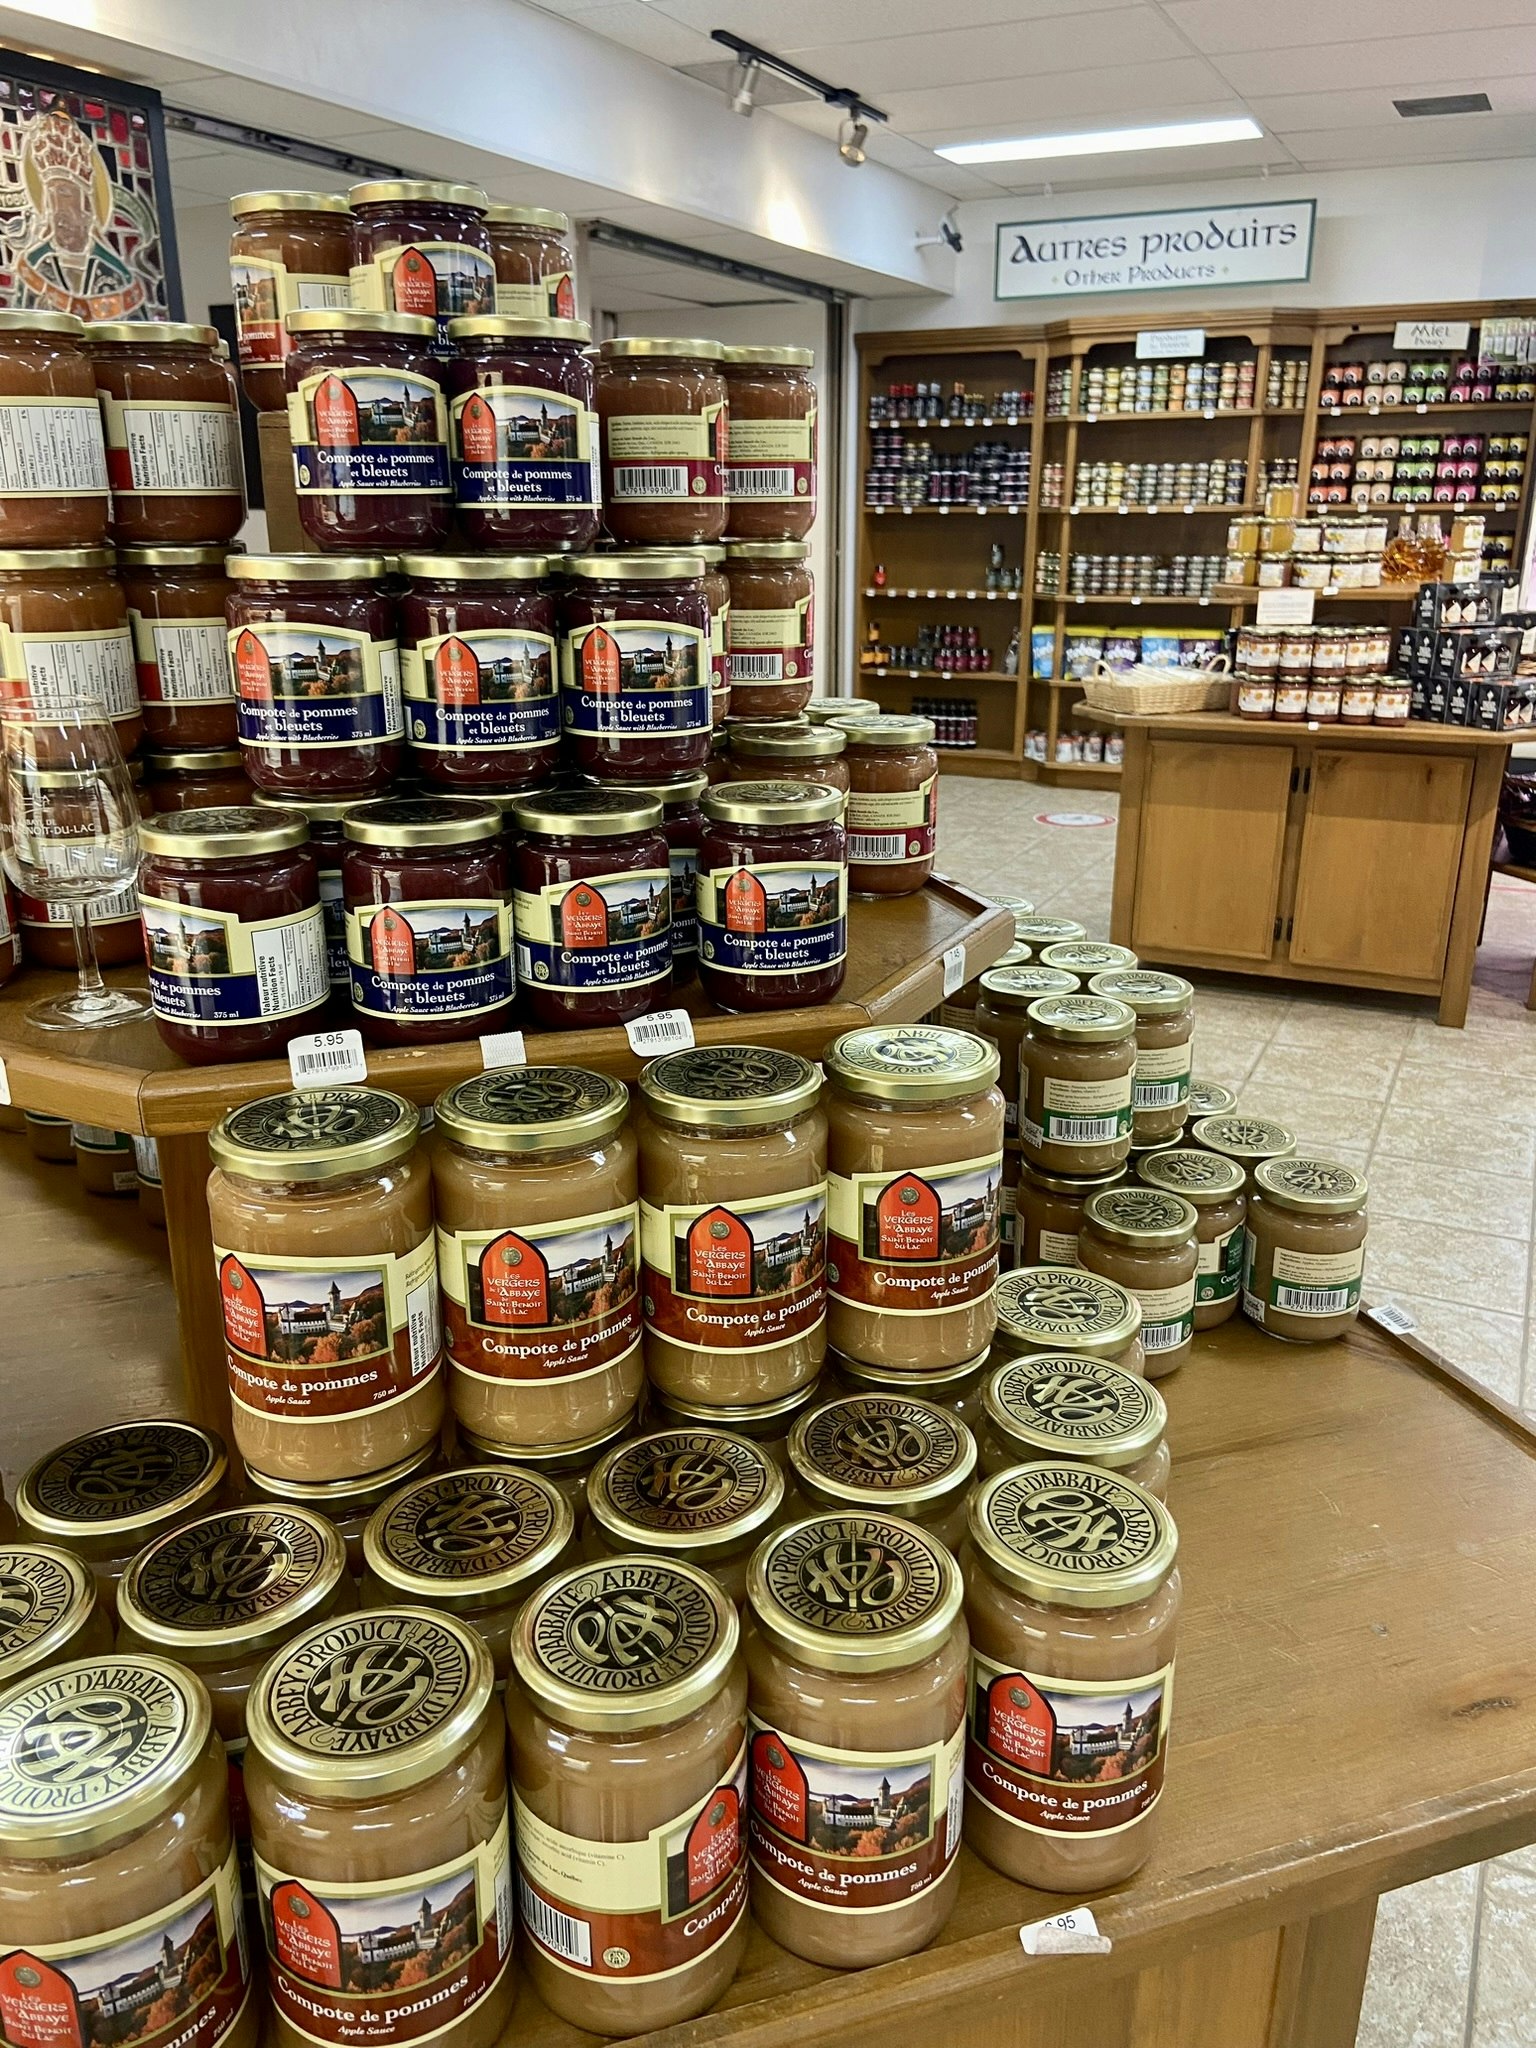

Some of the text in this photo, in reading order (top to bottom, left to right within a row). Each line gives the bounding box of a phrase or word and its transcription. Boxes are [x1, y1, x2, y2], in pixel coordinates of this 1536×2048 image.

[317, 450, 434, 466] Compote de pommes
[362, 464, 408, 477] bleuets
[463, 467, 572, 482] Compote de pommes
[497, 480, 542, 492] bleuets
[240, 703, 358, 720] Compote de pommes
[581, 696, 693, 712] Compote de pommes
[275, 719, 323, 731] bleuets
[436, 707, 549, 724] Compote de pommes
[621, 710, 665, 722] bleuets
[481, 722, 525, 734] bleuets
[724, 931, 834, 949] Compote de pommes
[561, 940, 668, 966] Compote de pommes
[765, 949, 809, 960] bleuets
[608, 960, 650, 975] bleuets
[161, 982, 221, 996] de pommes
[259, 956, 270, 1014] Valeur nutritive
[372, 972, 495, 994] Compote de pommes
[154, 988, 186, 1007] bleuets
[271, 977, 279, 1012] Nutrition
[416, 992, 465, 1004] bleuets
[647, 1012, 673, 1022] 5.95
[313, 1033, 345, 1047] 5.95
[874, 1272, 945, 1291] Compote
[948, 1274, 960, 1283] de
[931, 1286, 969, 1299] Apple Sauce
[1006, 1273, 1119, 1303] ABBEY PRODUCT
[686, 1287, 822, 1329] Compote de pommes
[482, 1314, 632, 1359] Compote de pommes
[744, 1323, 786, 1337] Apple Sauce
[543, 1353, 588, 1368] Apple Sauce
[227, 1355, 378, 1395] Compote de pommes
[1005, 1361, 1116, 1407] ABBEY PRODUCT
[265, 1394, 311, 1405] Apple Sauce
[373, 1386, 396, 1400] 750 ml
[865, 1401, 941, 1430] PRODUIT
[630, 1436, 715, 1467] PRODUCT
[390, 1475, 539, 1533] ABBEY PRODUCT
[991, 1472, 1117, 1536] PRODUIT D'ABBAYE
[163, 1515, 318, 1568] PRODUCT PRODUIT
[493, 1509, 550, 1571] PRODUIT
[773, 1522, 934, 1577] PRODUCT PRODUIT
[1017, 1509, 1152, 1571] ABBEY PRODUCT
[865, 1576, 935, 1631] D'ABBAYE
[538, 1570, 711, 1669] D'ABBAYE ABBEY PRODUCT
[276, 1620, 463, 1738] ABBEY PRODUCT PRODUIT
[557, 1665, 663, 1689] PRODUIT
[75, 1669, 176, 1711] D'ABBAYE
[331, 1697, 448, 1752] D'ABBAYE
[99, 1724, 177, 1793] ABBEY
[982, 1762, 1148, 1813] Compote de pommes
[1040, 1810, 1090, 1822] Apple Sauce
[750, 1819, 918, 1887] Compote de pommes
[798, 1878, 848, 1896] Apple Sauce
[683, 1878, 744, 1937] Compote
[278, 1974, 469, 2024] Compote de pommes
[338, 2025, 396, 2036] Apple Sauce
